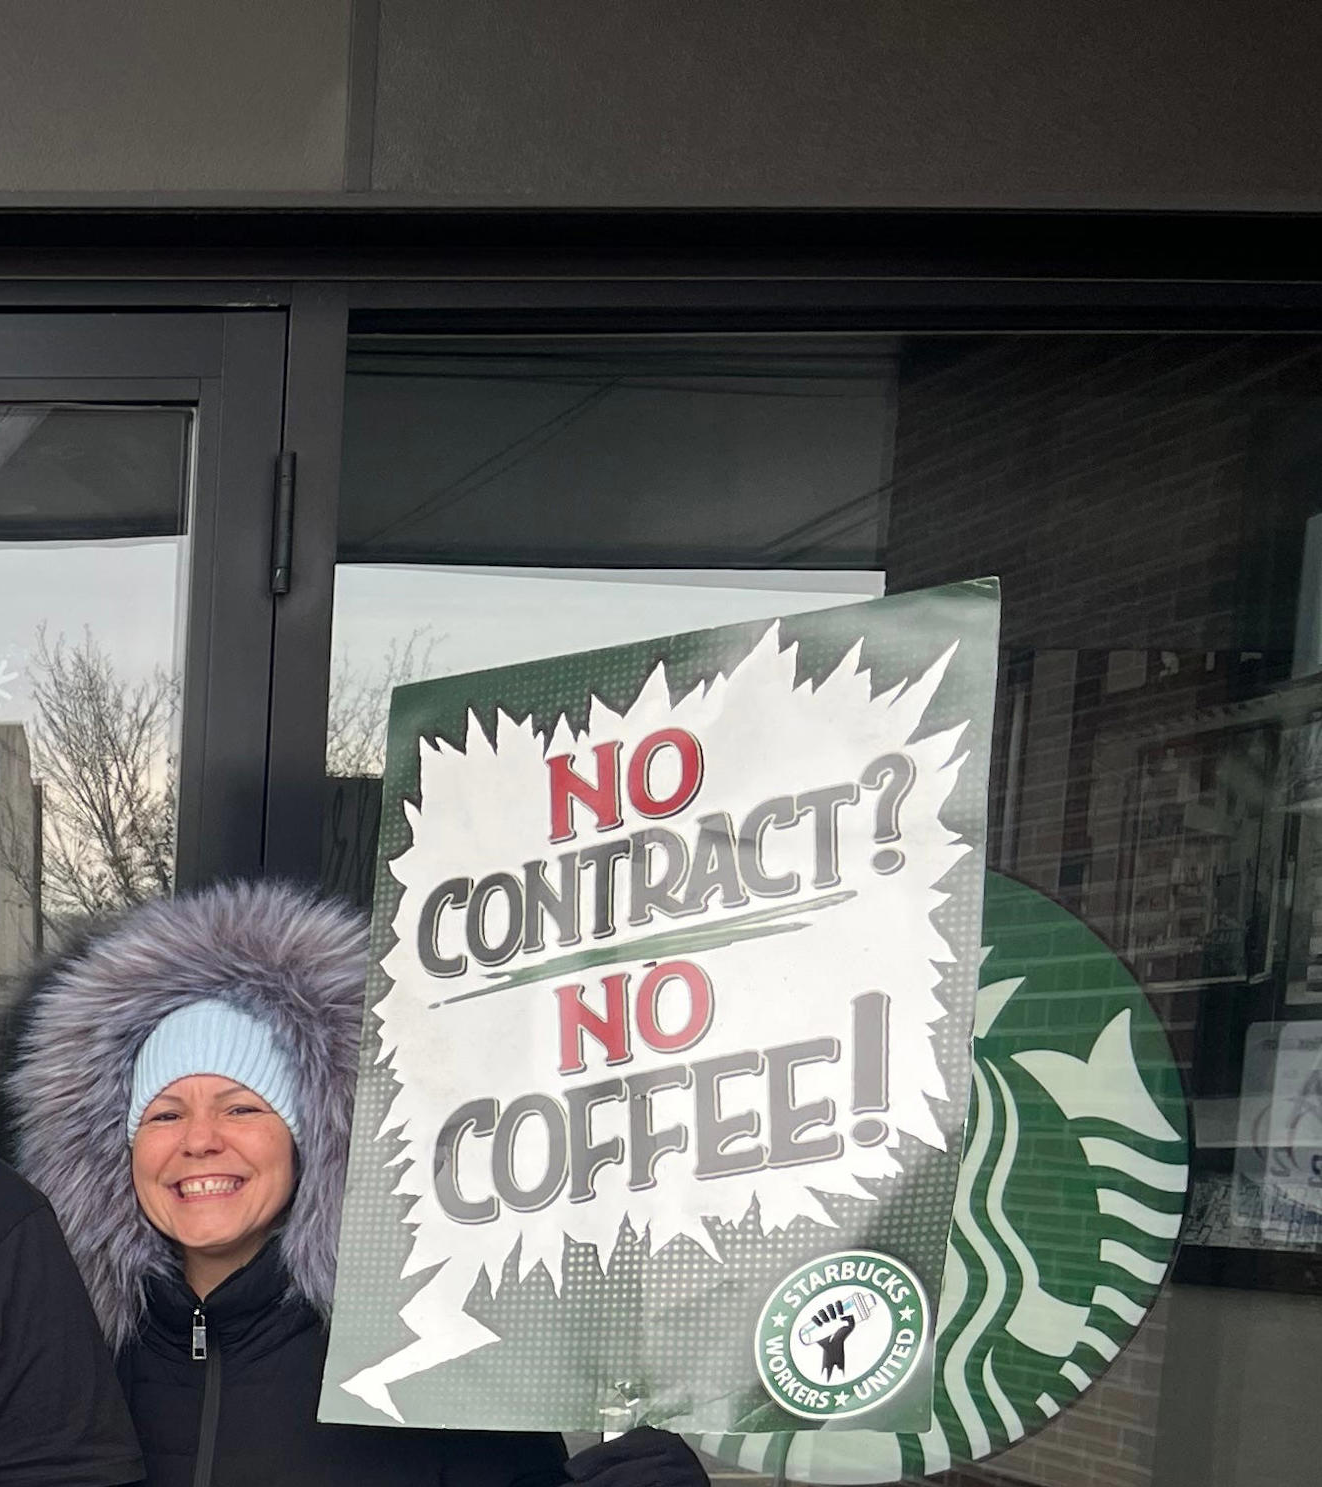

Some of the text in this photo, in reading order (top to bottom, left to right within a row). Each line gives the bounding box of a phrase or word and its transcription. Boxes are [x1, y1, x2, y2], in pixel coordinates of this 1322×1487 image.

[547, 727, 704, 843] NO
[418, 752, 917, 977] CONTRACT?
[557, 959, 715, 1075] NO
[432, 991, 892, 1225] COFFEE!
[783, 1261, 910, 1308] STARBUCKS
[766, 1328, 915, 1409] WORKERS UNITED
